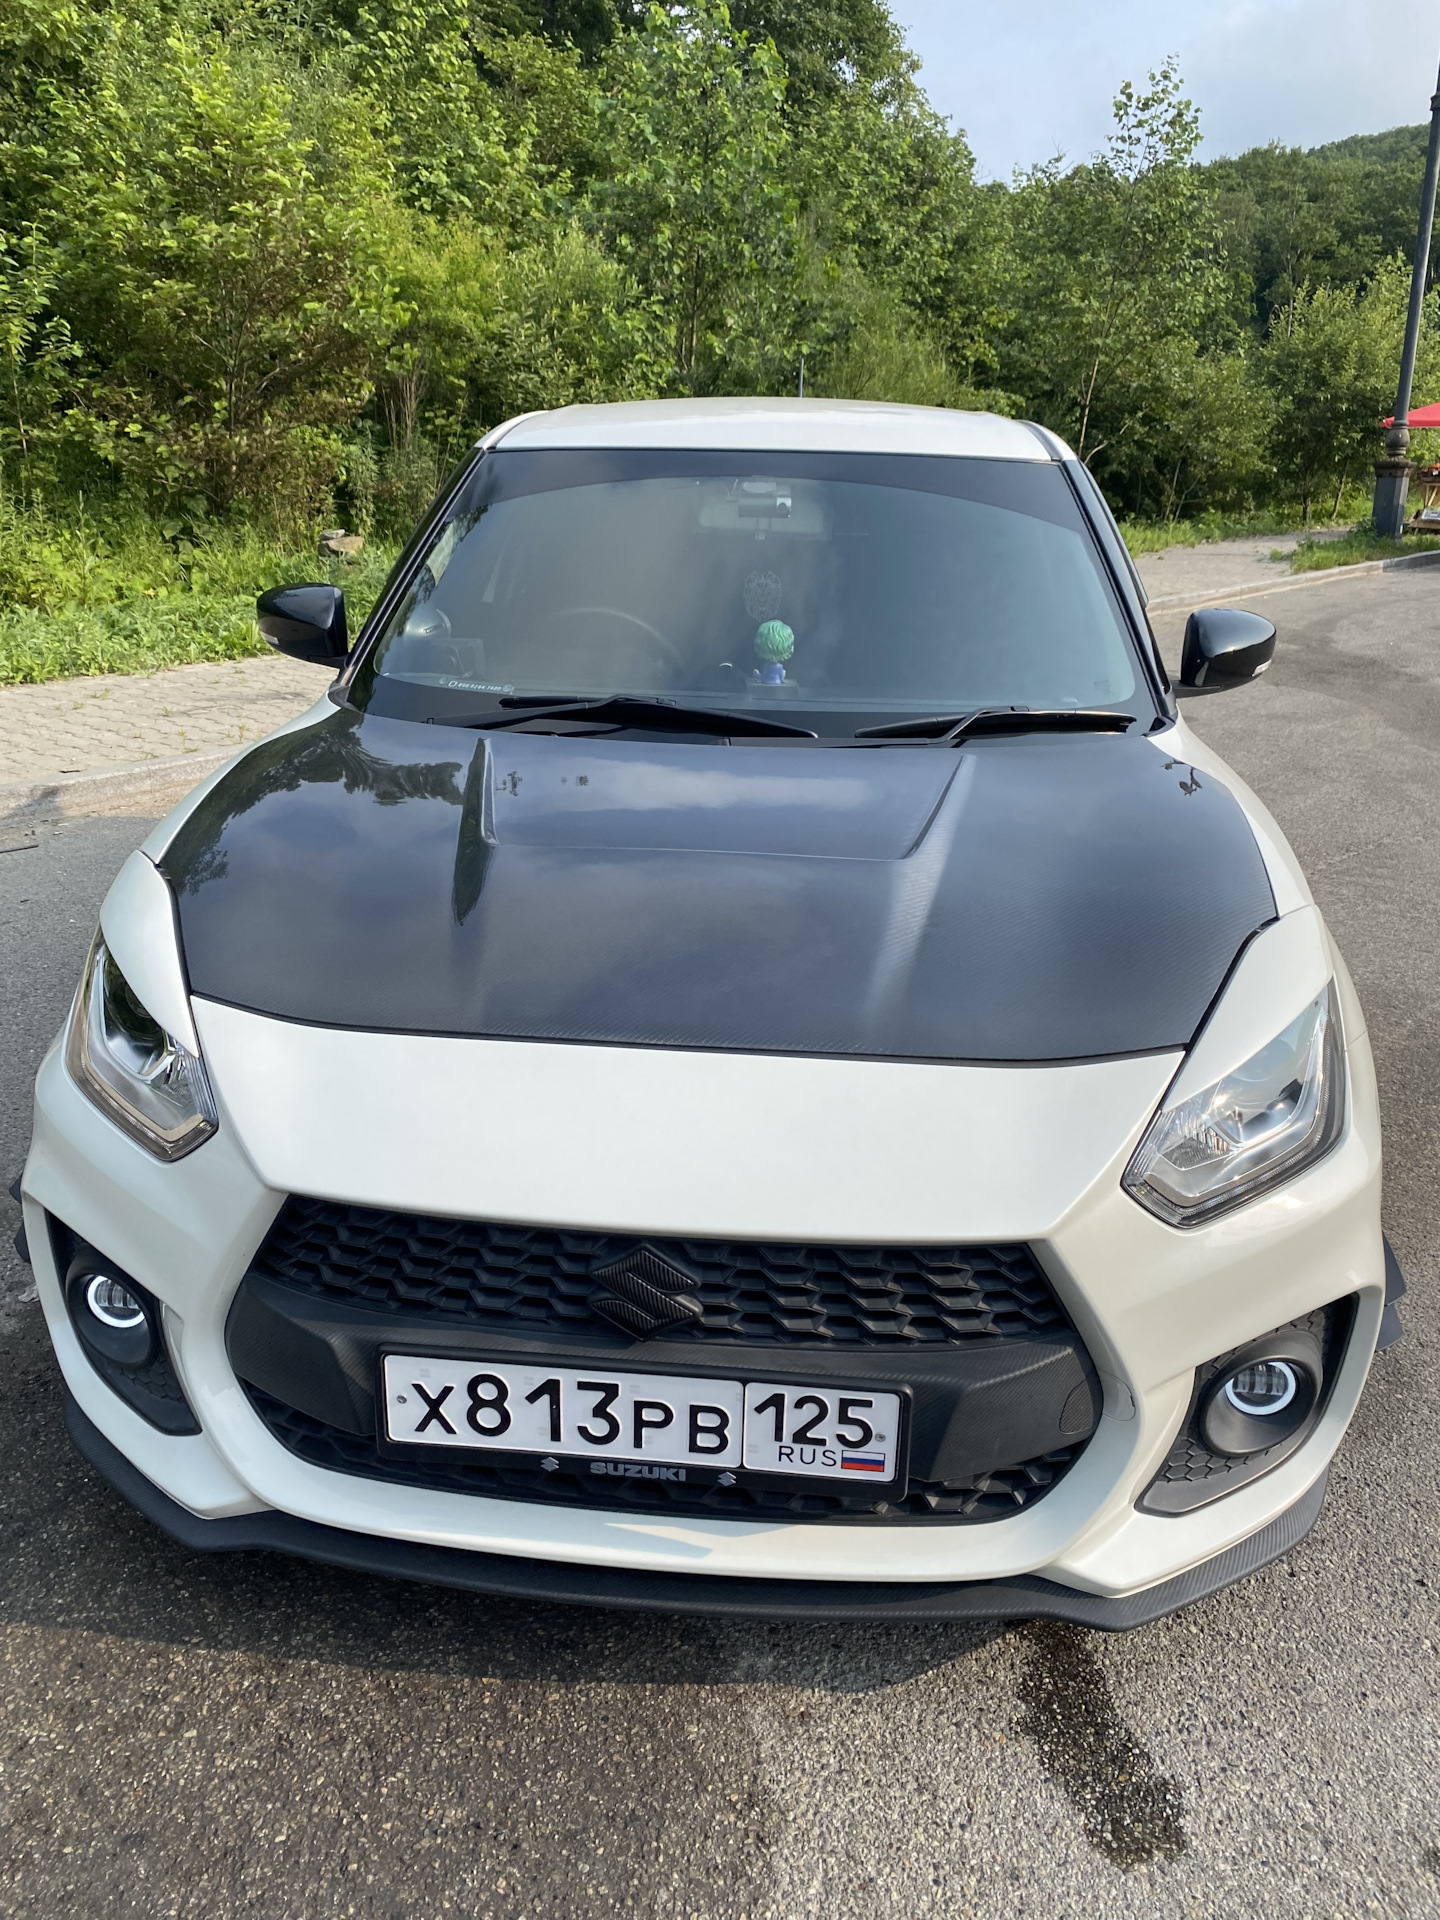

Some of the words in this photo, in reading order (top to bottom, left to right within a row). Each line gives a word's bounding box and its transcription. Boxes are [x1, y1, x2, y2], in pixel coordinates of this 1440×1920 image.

[753, 1392, 873, 1449] 125
[778, 1445, 837, 1467] RUS
[589, 1461, 687, 1482] SUZUKI
